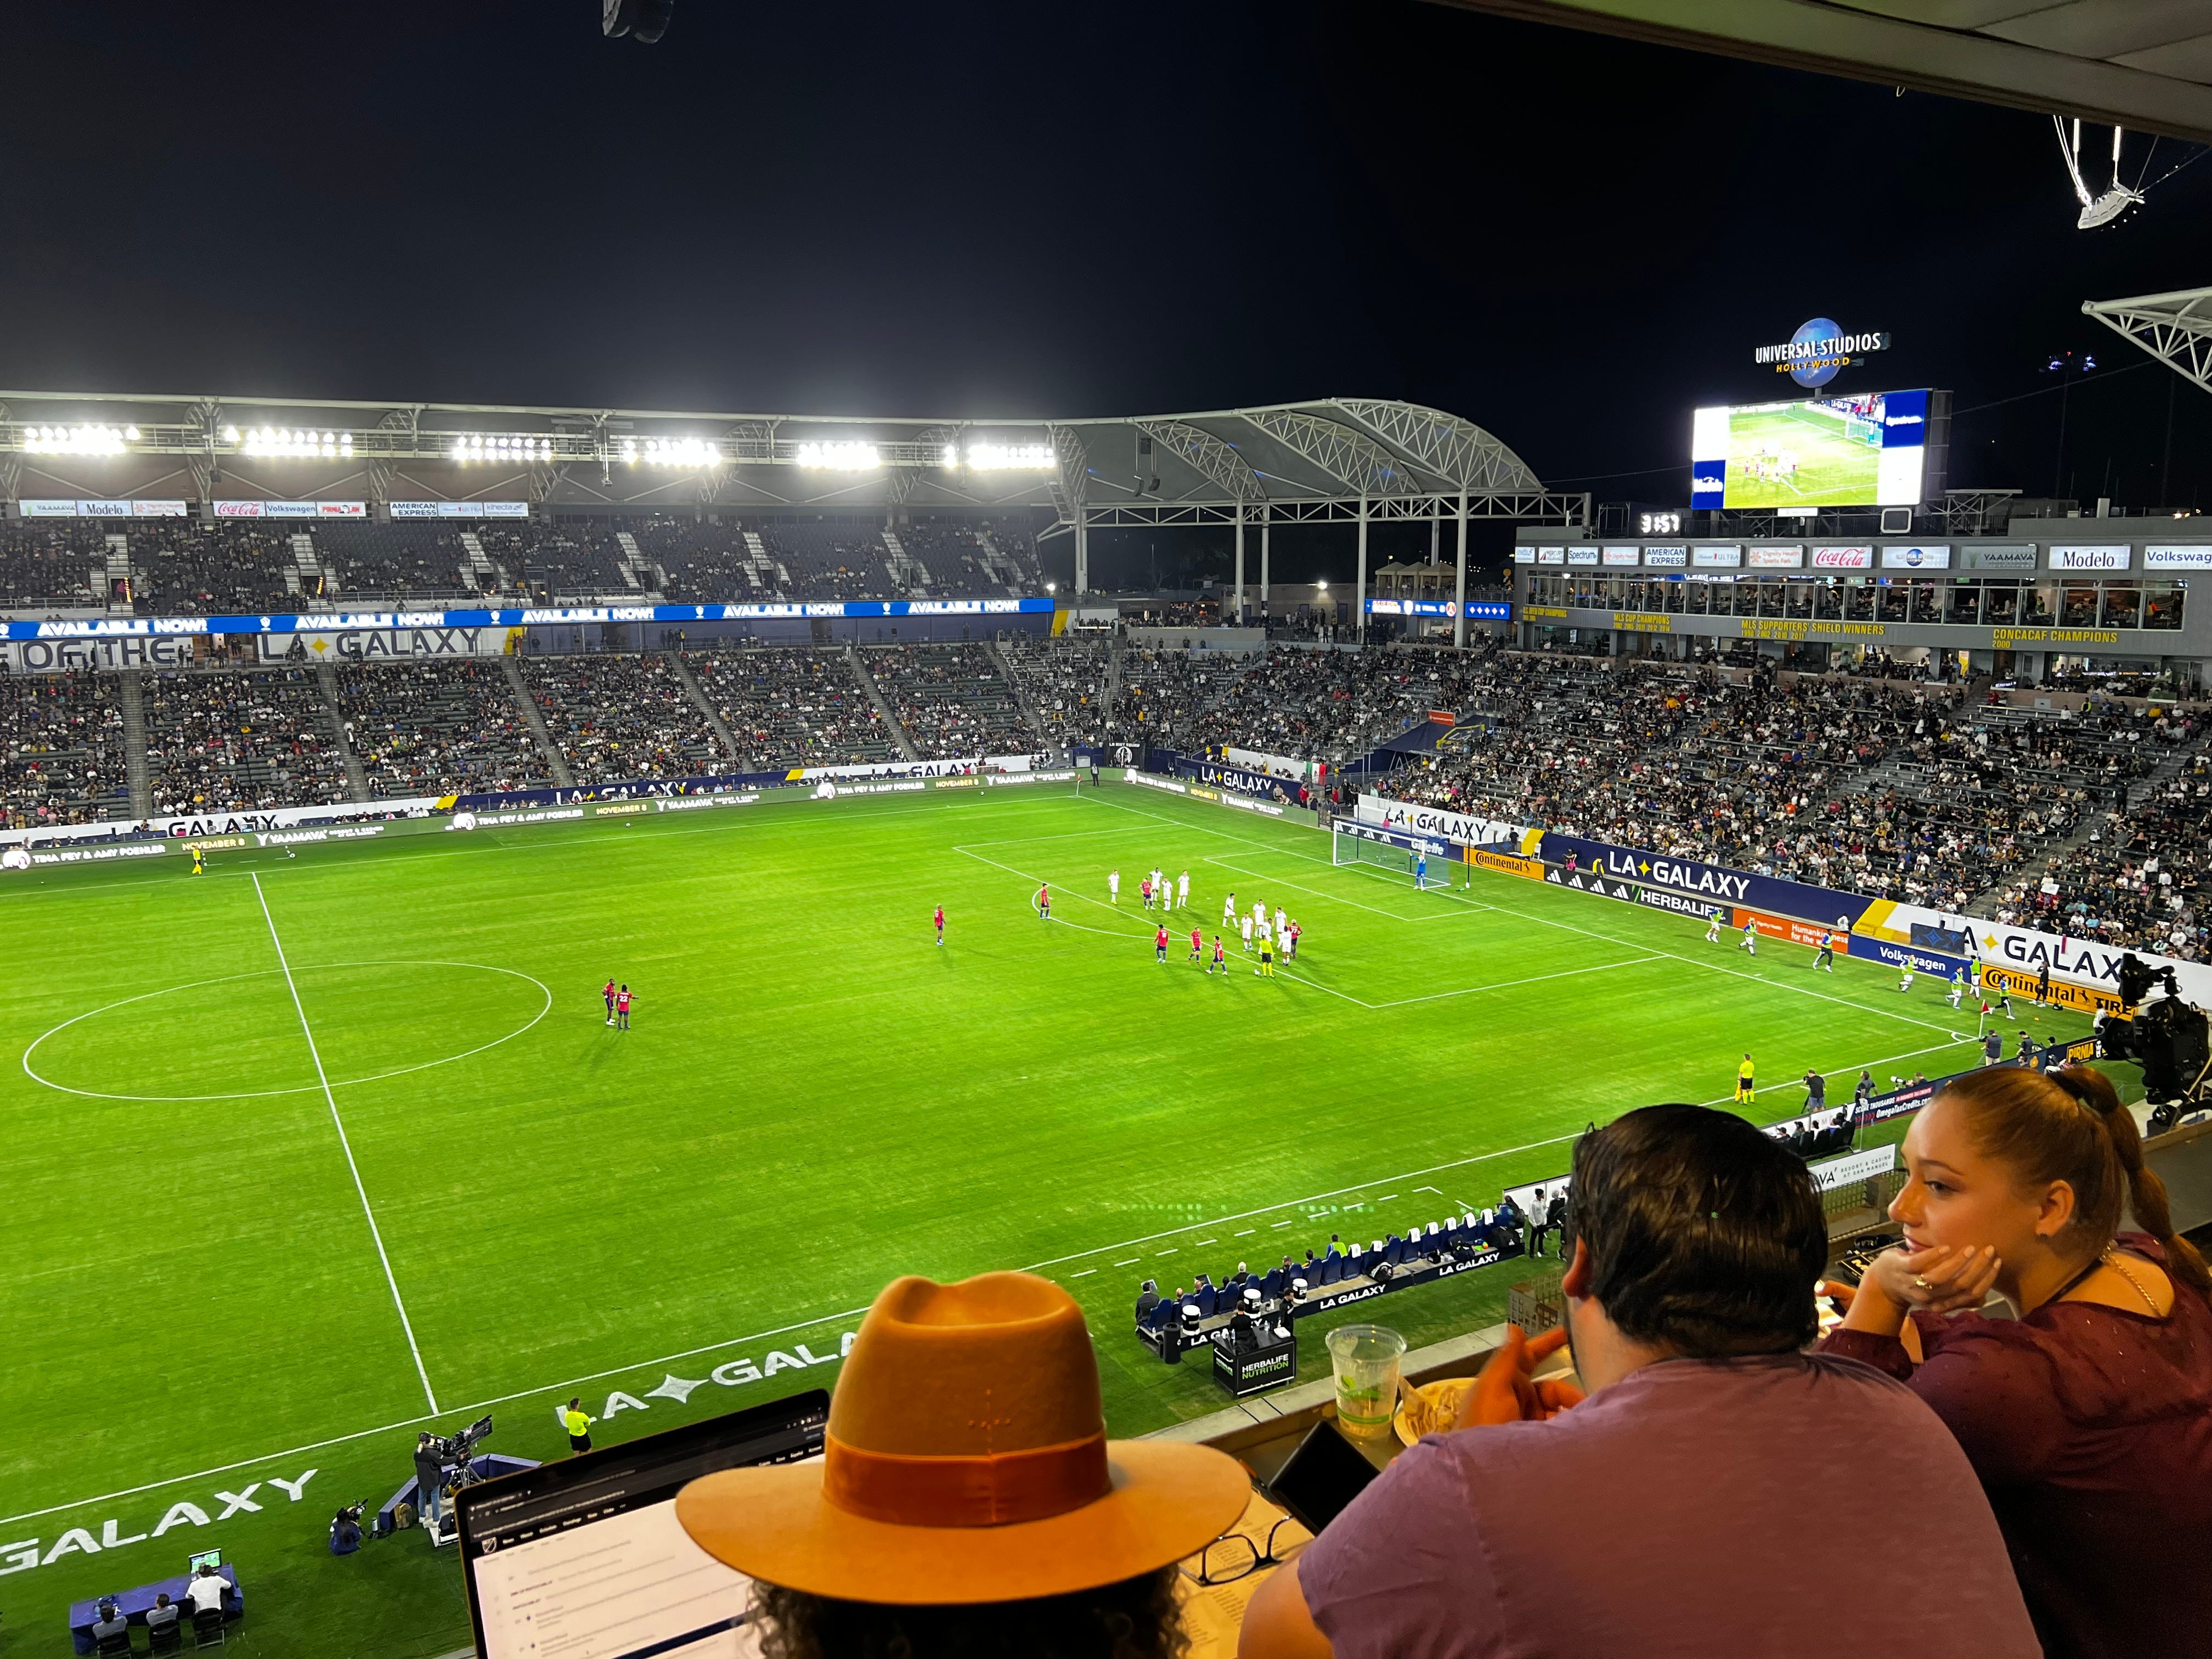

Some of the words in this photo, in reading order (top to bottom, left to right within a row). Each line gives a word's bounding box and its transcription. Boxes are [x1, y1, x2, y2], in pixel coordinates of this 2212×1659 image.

[1756, 340, 1818, 364] UNIVERSAL
[1820, 332, 1881, 356] STUDIOS
[1776, 357, 1850, 373] HOLLYWOOD
[86, 503, 123, 515] Modelo
[267, 505, 316, 514] Volkswagen
[1568, 550, 1595, 560] Spectrum
[2062, 551, 2115, 567] Modelo
[521, 608, 609, 623] AVAILABLE
[612, 607, 655, 620] NOW!
[723, 604, 802, 618] AVAILABLE
[806, 603, 845, 616] NOW!
[908, 601, 981, 614] AVAILABLE
[984, 600, 1020, 612] NOW!
[295, 614, 393, 629] AVAILABLE
[397, 613, 445, 627] NOW!
[1613, 613, 1624, 622] MLS
[1626, 614, 1636, 623] CUP
[1637, 614, 1671, 624] CHAMPIONS
[37, 620, 149, 637] AVAILABLE
[154, 618, 208, 633] NOW!
[1741, 619, 1757, 629] MLS
[1812, 622, 1841, 633] SHIELD
[1843, 624, 1885, 635] WINNERS
[1774, 631, 1788, 639] 2010
[336, 627, 482, 658] GALAXY
[1992, 640, 2011, 648] 2000
[1993, 629, 2048, 641] CONCACAF
[2050, 630, 2118, 643] CHAMPIONS
[22, 638, 82, 669] OF
[97, 636, 177, 666] THE
[935, 779, 973, 788] NOVEMBER
[1201, 766, 1217, 784] LA
[1223, 771, 1272, 792] GALAXY
[596, 805, 640, 816] NOVEMBER
[1386, 806, 1406, 825] LA
[1417, 813, 1487, 842] GALAXY
[182, 838, 238, 851] NOVEMBER
[1475, 851, 1523, 872] Continental
[1609, 851, 1637, 877] LA
[1652, 861, 1750, 900] GALAXY
[1640, 889, 1720, 918] HERBALIF
[1791, 932, 1800, 941] for
[1802, 934, 1814, 944] the
[2004, 935, 2121, 983] GALAX
[2068, 1042, 2094, 1063] PIRNIA
[1841, 1163, 1863, 1173] RESORT
[1871, 1154, 1892, 1164] CASINO
[1866, 1162, 1888, 1171] MANUEL
[1440, 1266, 1454, 1277] LA
[1455, 1252, 1500, 1272] GALAXY
[1320, 1299, 1336, 1310] LA
[1338, 1284, 1386, 1304] GALAXY
[1190, 1334, 1208, 1346] LA
[1242, 1353, 1289, 1373] HERBALIFE
[1242, 1361, 1289, 1380] NUTRITION
[0, 1468, 318, 1576] GALAXY
